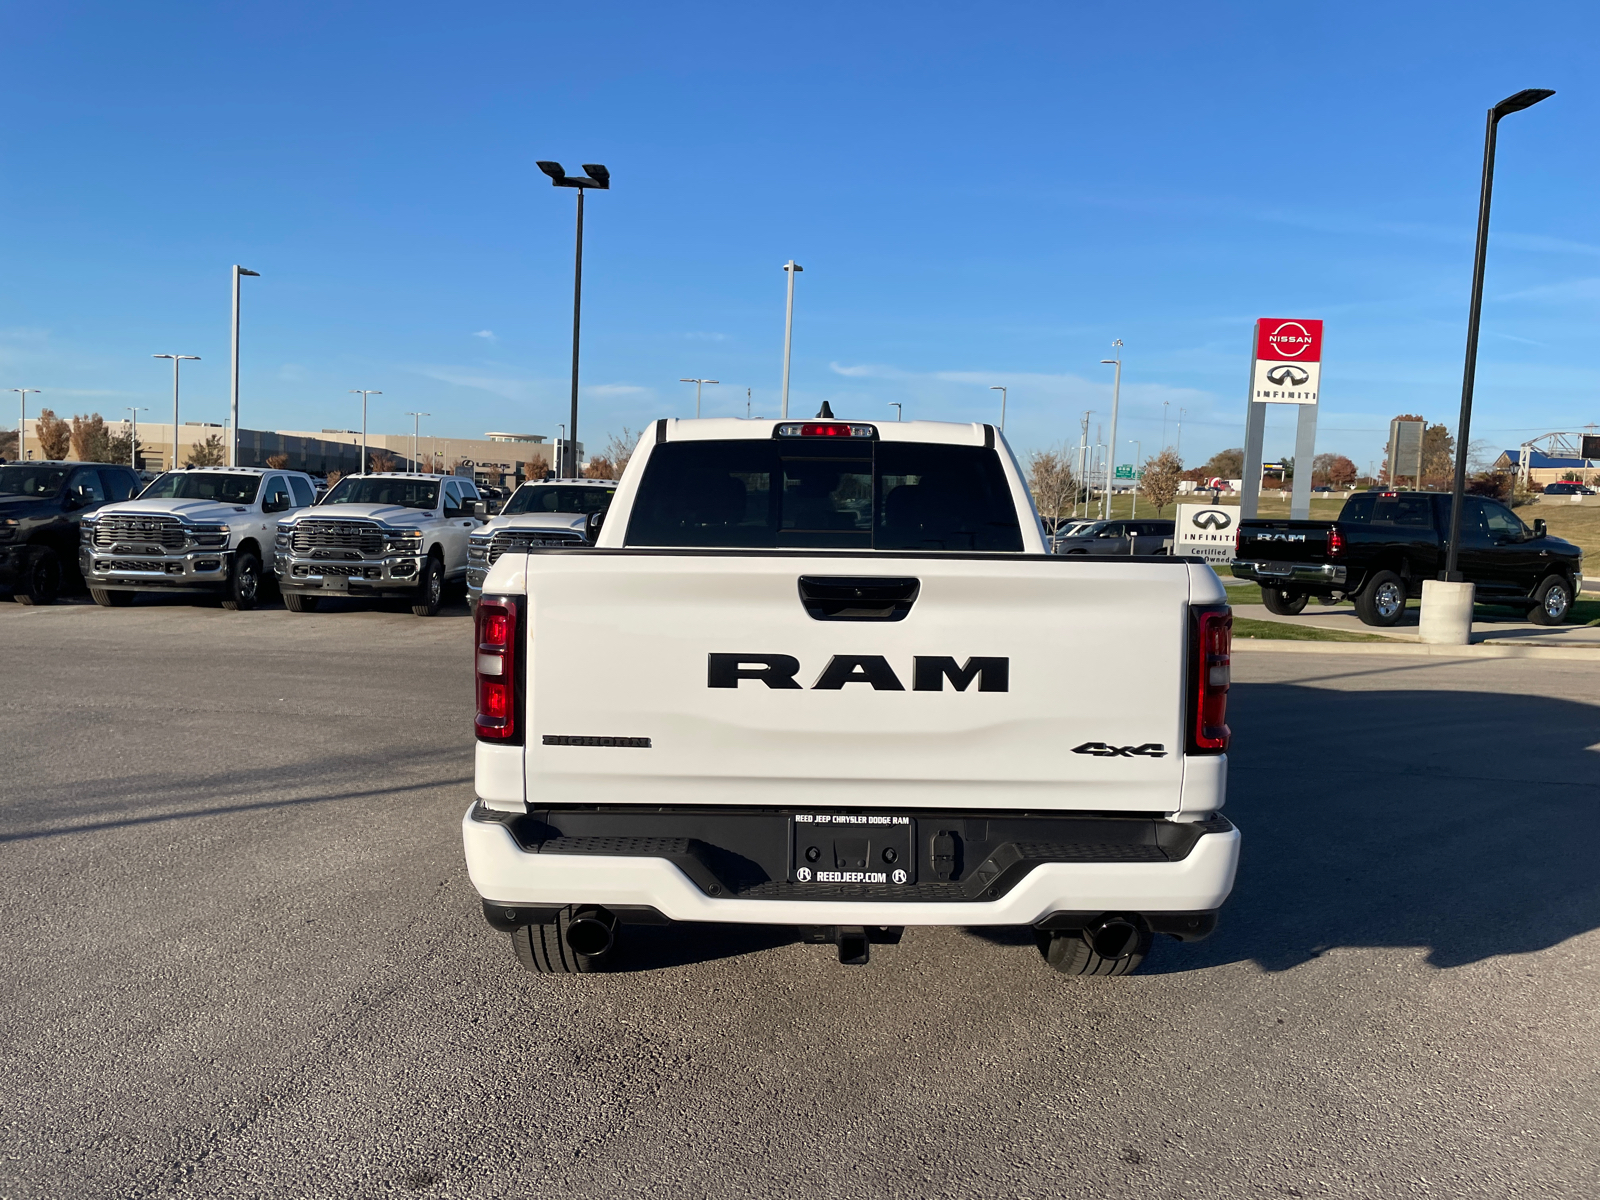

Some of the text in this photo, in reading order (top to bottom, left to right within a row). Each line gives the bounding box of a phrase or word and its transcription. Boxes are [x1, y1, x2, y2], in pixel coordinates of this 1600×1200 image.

[1269, 335, 1312, 343] NISSAN
[1257, 390, 1316, 400] INFINITI
[1184, 533, 1235, 542] INFINITI
[1257, 533, 1306, 542] RAM
[1191, 548, 1227, 556] Certified
[707, 652, 1010, 693] RAM
[795, 815, 909, 825] REED JEEP CHRYSLER DODGE RAM
[817, 871, 887, 883] REEDJEEP.COM
